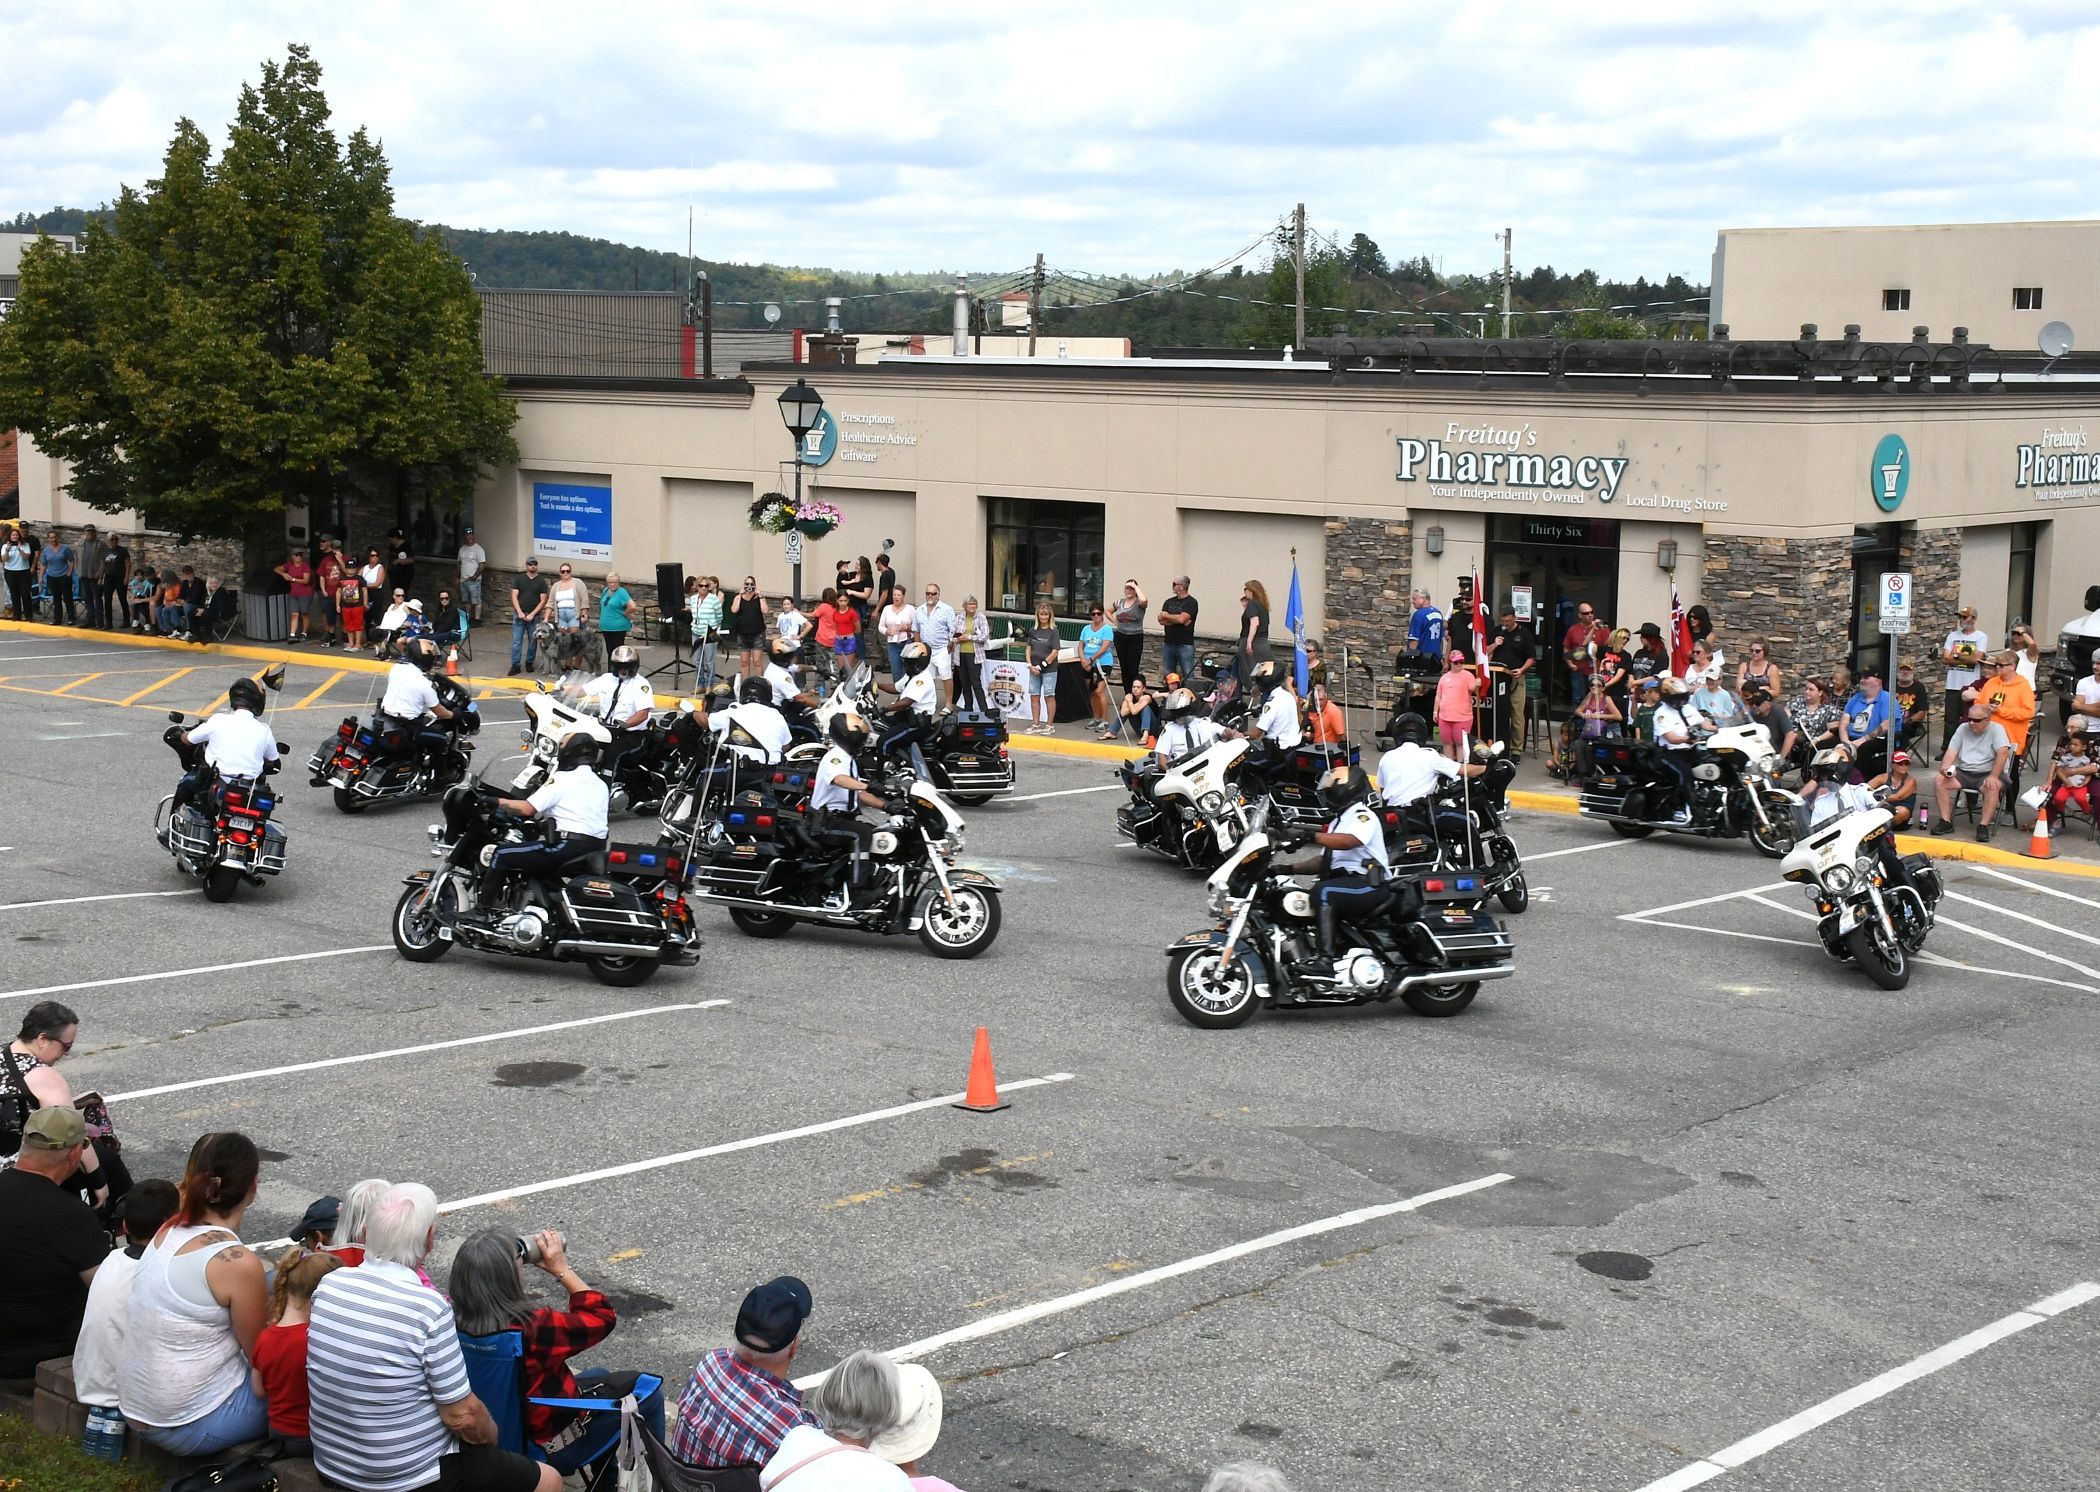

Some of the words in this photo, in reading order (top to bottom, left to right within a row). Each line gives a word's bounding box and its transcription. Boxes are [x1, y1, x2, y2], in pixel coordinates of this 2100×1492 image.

[841, 411, 896, 427] Prescriptions
[841, 431, 885, 444] Healthcare
[887, 433, 917, 446] Advice
[1444, 422, 1537, 451] Freitag's
[2041, 424, 2087, 453] Freitag's
[841, 449, 877, 462] Giftware
[1396, 437, 1629, 503] Pharmacy
[561, 494, 569, 502] has
[1430, 485, 1457, 498] Your
[1459, 486, 1539, 505] Independently
[1542, 490, 1585, 504] Owned
[2034, 488, 2048, 502] Your
[1626, 494, 1657, 508] Local
[1661, 496, 1692, 513] Drug
[1695, 498, 1728, 512] Store
[1528, 523, 1561, 539] Thirty
[1565, 524, 1582, 537] Six
[791, 535, 796, 543] P
[1428, 622, 1441, 640] 19
[1229, 754, 1246, 769] POLICE
[1864, 827, 1886, 842] POLICE
[961, 872, 986, 881] POLICE
[587, 880, 612, 890] POLICE
[1184, 932, 1211, 941] POLICE
